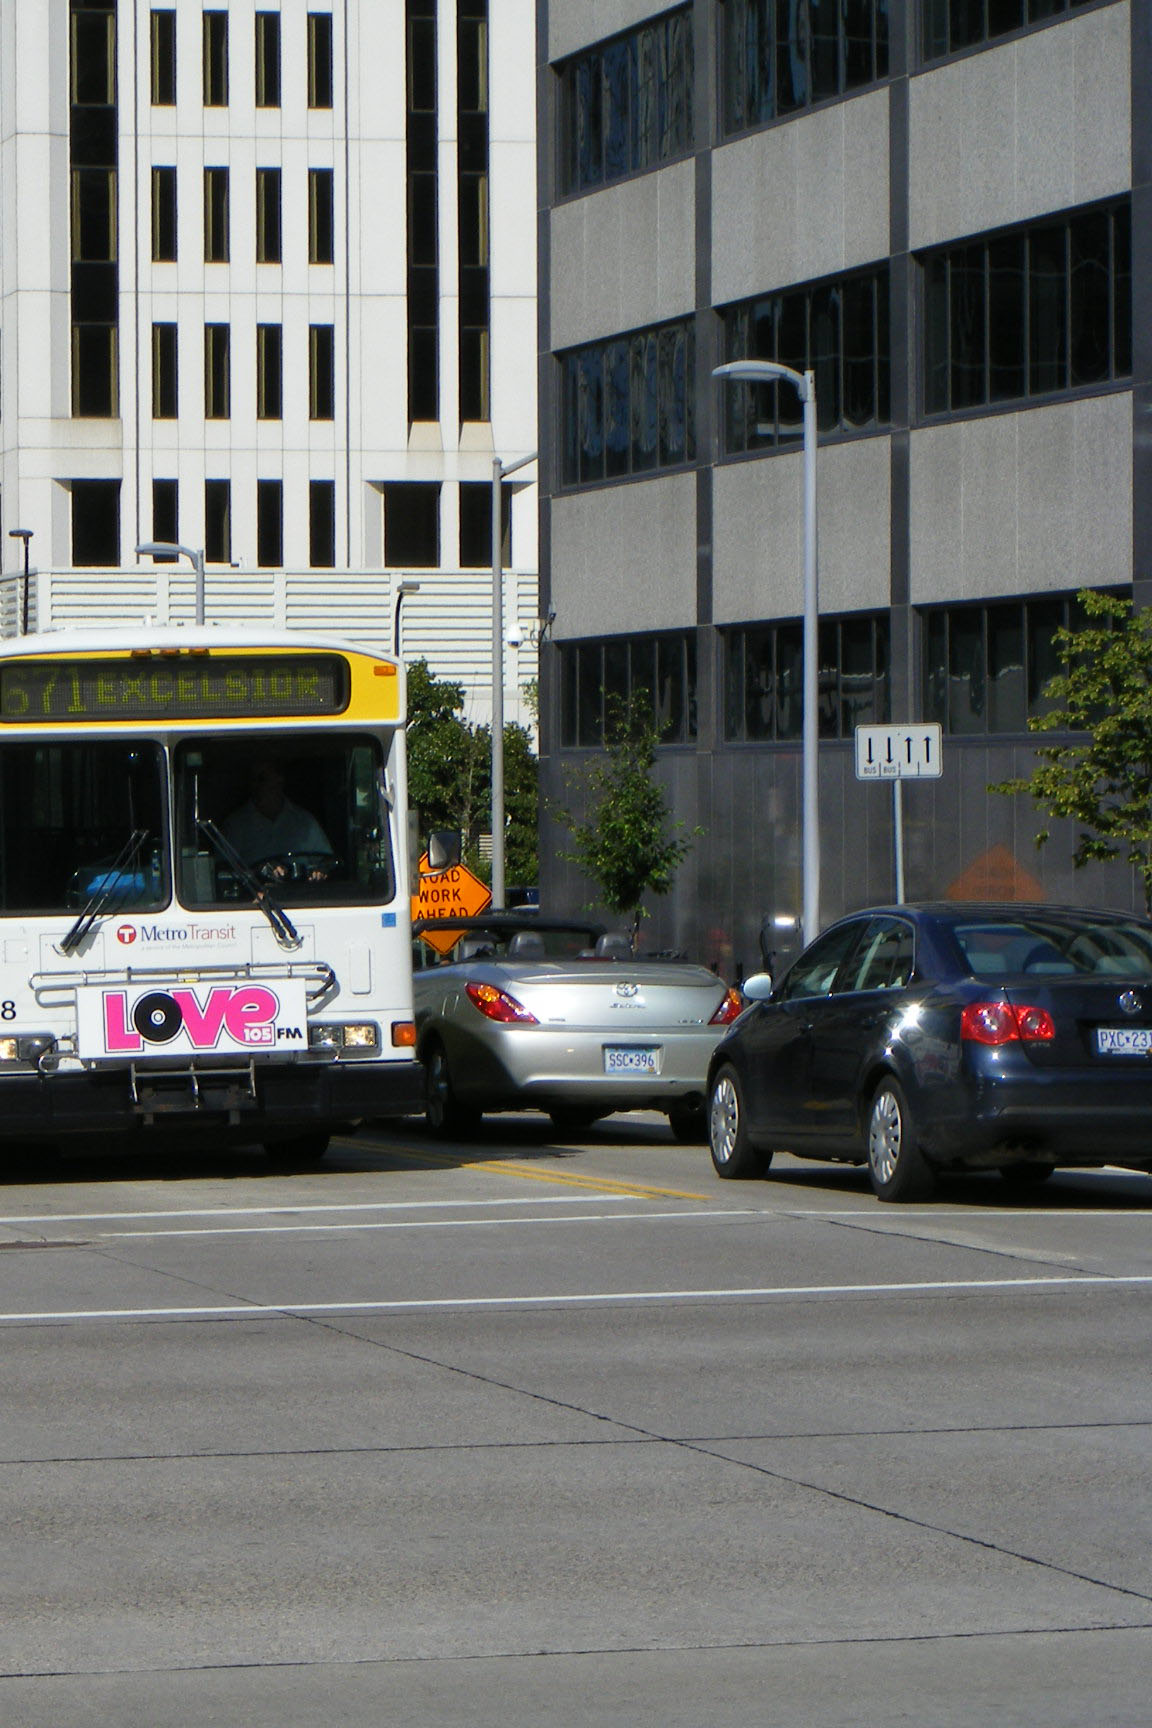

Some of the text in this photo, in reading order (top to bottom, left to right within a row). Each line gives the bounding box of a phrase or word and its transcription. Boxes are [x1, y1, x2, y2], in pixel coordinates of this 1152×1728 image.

[96, 668, 320, 704] EXCELSIOR
[419, 888, 462, 903] WORK
[417, 907, 469, 920] AHEAD
[242, 1026, 303, 1042] 105 FM
